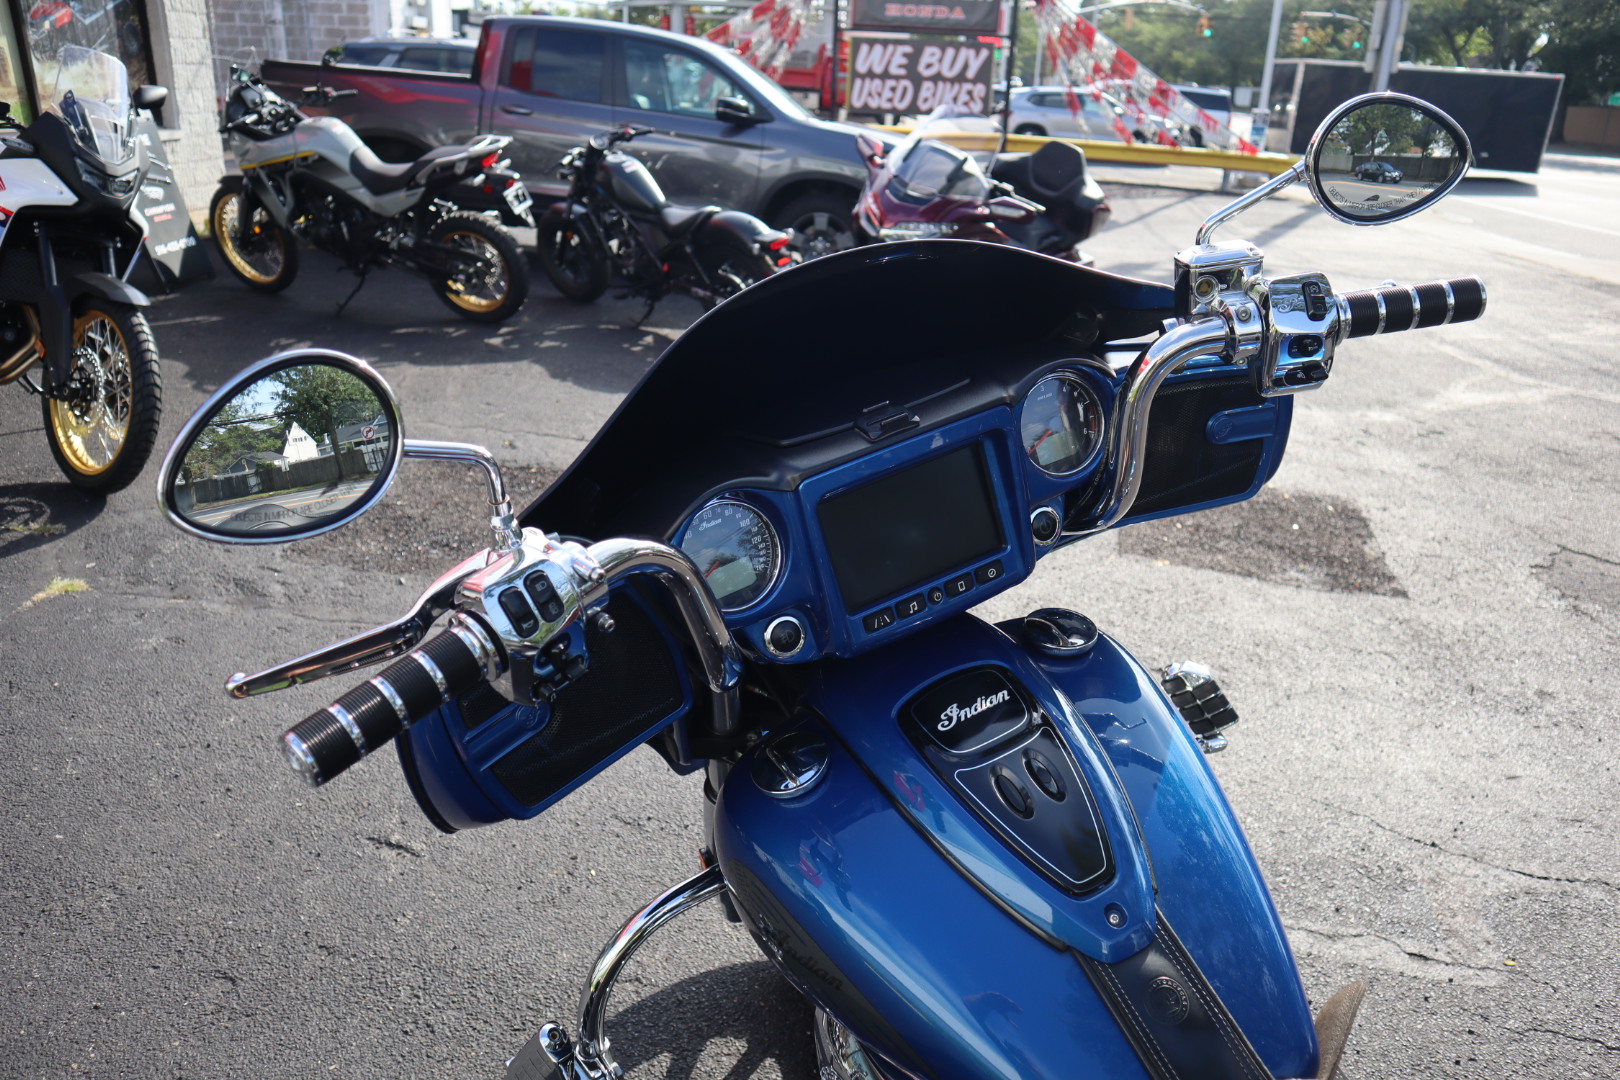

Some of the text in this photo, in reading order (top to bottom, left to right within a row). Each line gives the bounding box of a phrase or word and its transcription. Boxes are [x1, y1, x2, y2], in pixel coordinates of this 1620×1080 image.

[885, 3, 966, 19] HONDA
[854, 42, 989, 80] WE BUY
[850, 78, 986, 114] USED BIKES
[724, 507, 733, 517] 80
[698, 518, 722, 531] Indian
[751, 535, 762, 545] 120
[937, 688, 1011, 732] Indian
